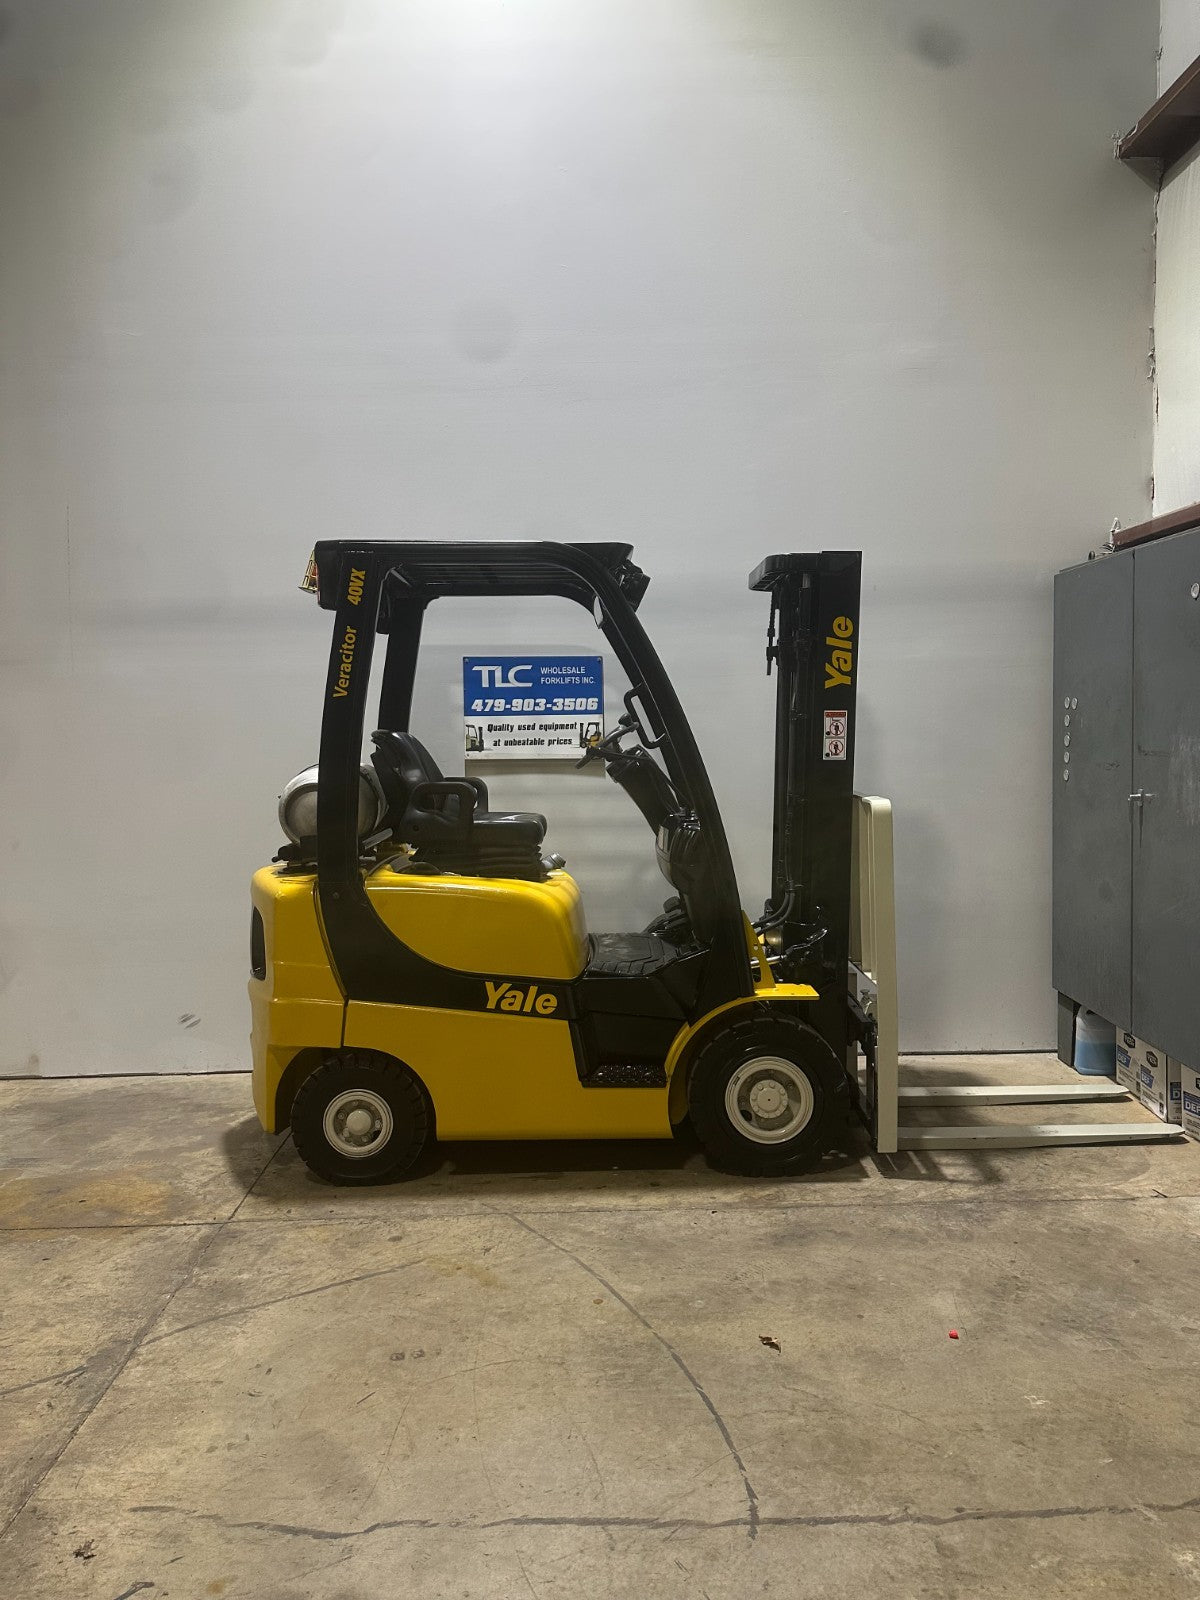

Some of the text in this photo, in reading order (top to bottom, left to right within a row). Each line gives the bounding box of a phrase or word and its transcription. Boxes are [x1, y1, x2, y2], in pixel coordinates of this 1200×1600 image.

[333, 568, 366, 698] Veracitor 40VX
[825, 615, 853, 689] Yale
[472, 665, 533, 688] TLC
[540, 666, 586, 675] WHOLESALE
[541, 676, 597, 685] FORKLIFTS INC.
[471, 697, 599, 712] 479-903-3506
[487, 722, 578, 733] Quality used equipment
[493, 739, 501, 747] at
[503, 737, 545, 747] unbeatable
[484, 981, 558, 1015] Yale
